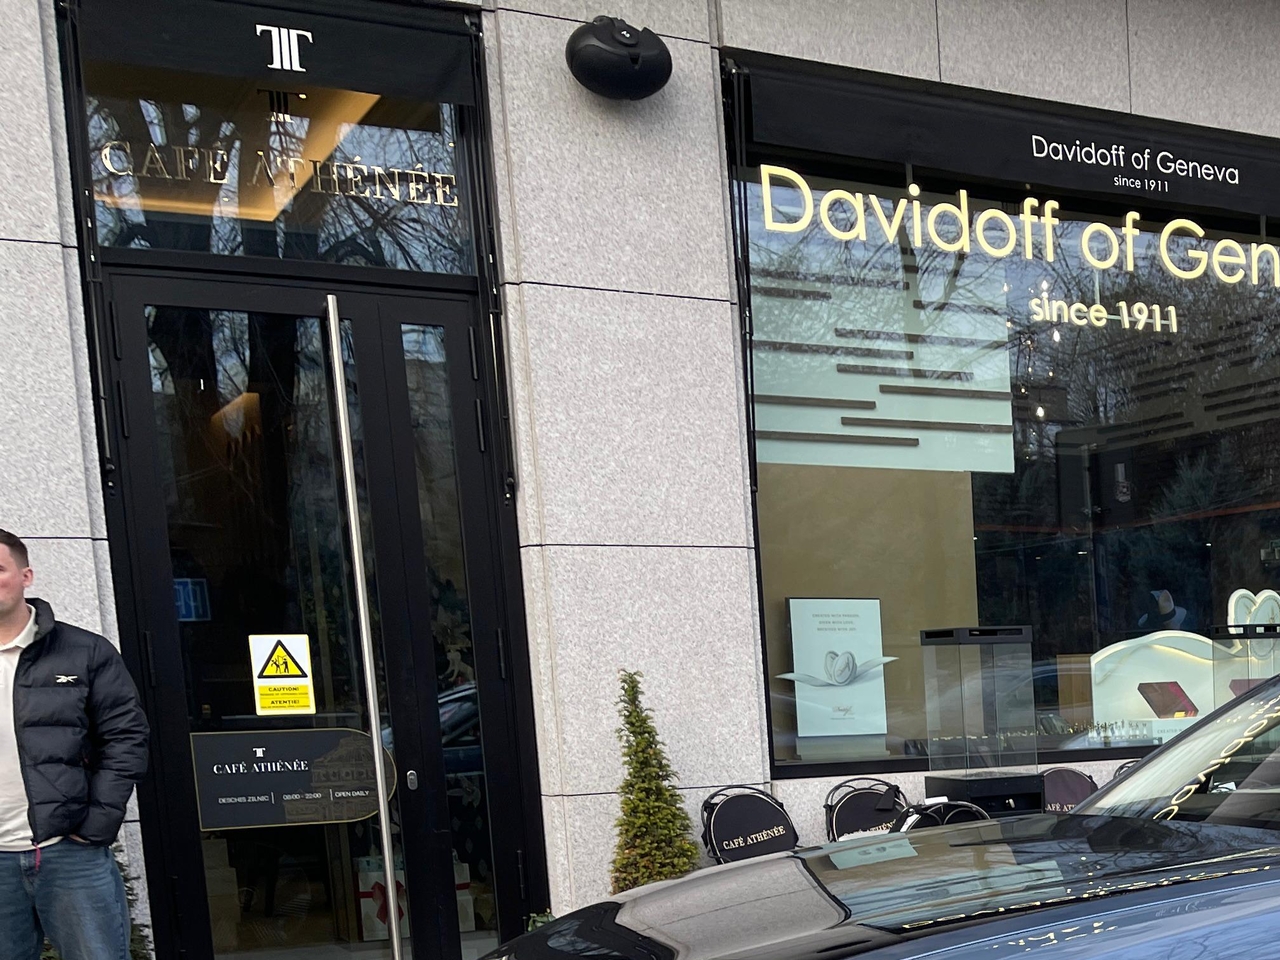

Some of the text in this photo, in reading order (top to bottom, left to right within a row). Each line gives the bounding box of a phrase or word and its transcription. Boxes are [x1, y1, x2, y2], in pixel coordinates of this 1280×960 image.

[246, 149, 459, 207] ATHÉNÉE
[1031, 135, 1239, 185] Davidoff of Geneva
[1113, 174, 1170, 193] since 1911
[759, 163, 1059, 262] Davidoff
[1081, 211, 1140, 272] of
[1030, 294, 1178, 333] since 1911
[213, 761, 248, 774] CAFÉ
[722, 825, 786, 850] CAFÉ ATHÉNÉE
